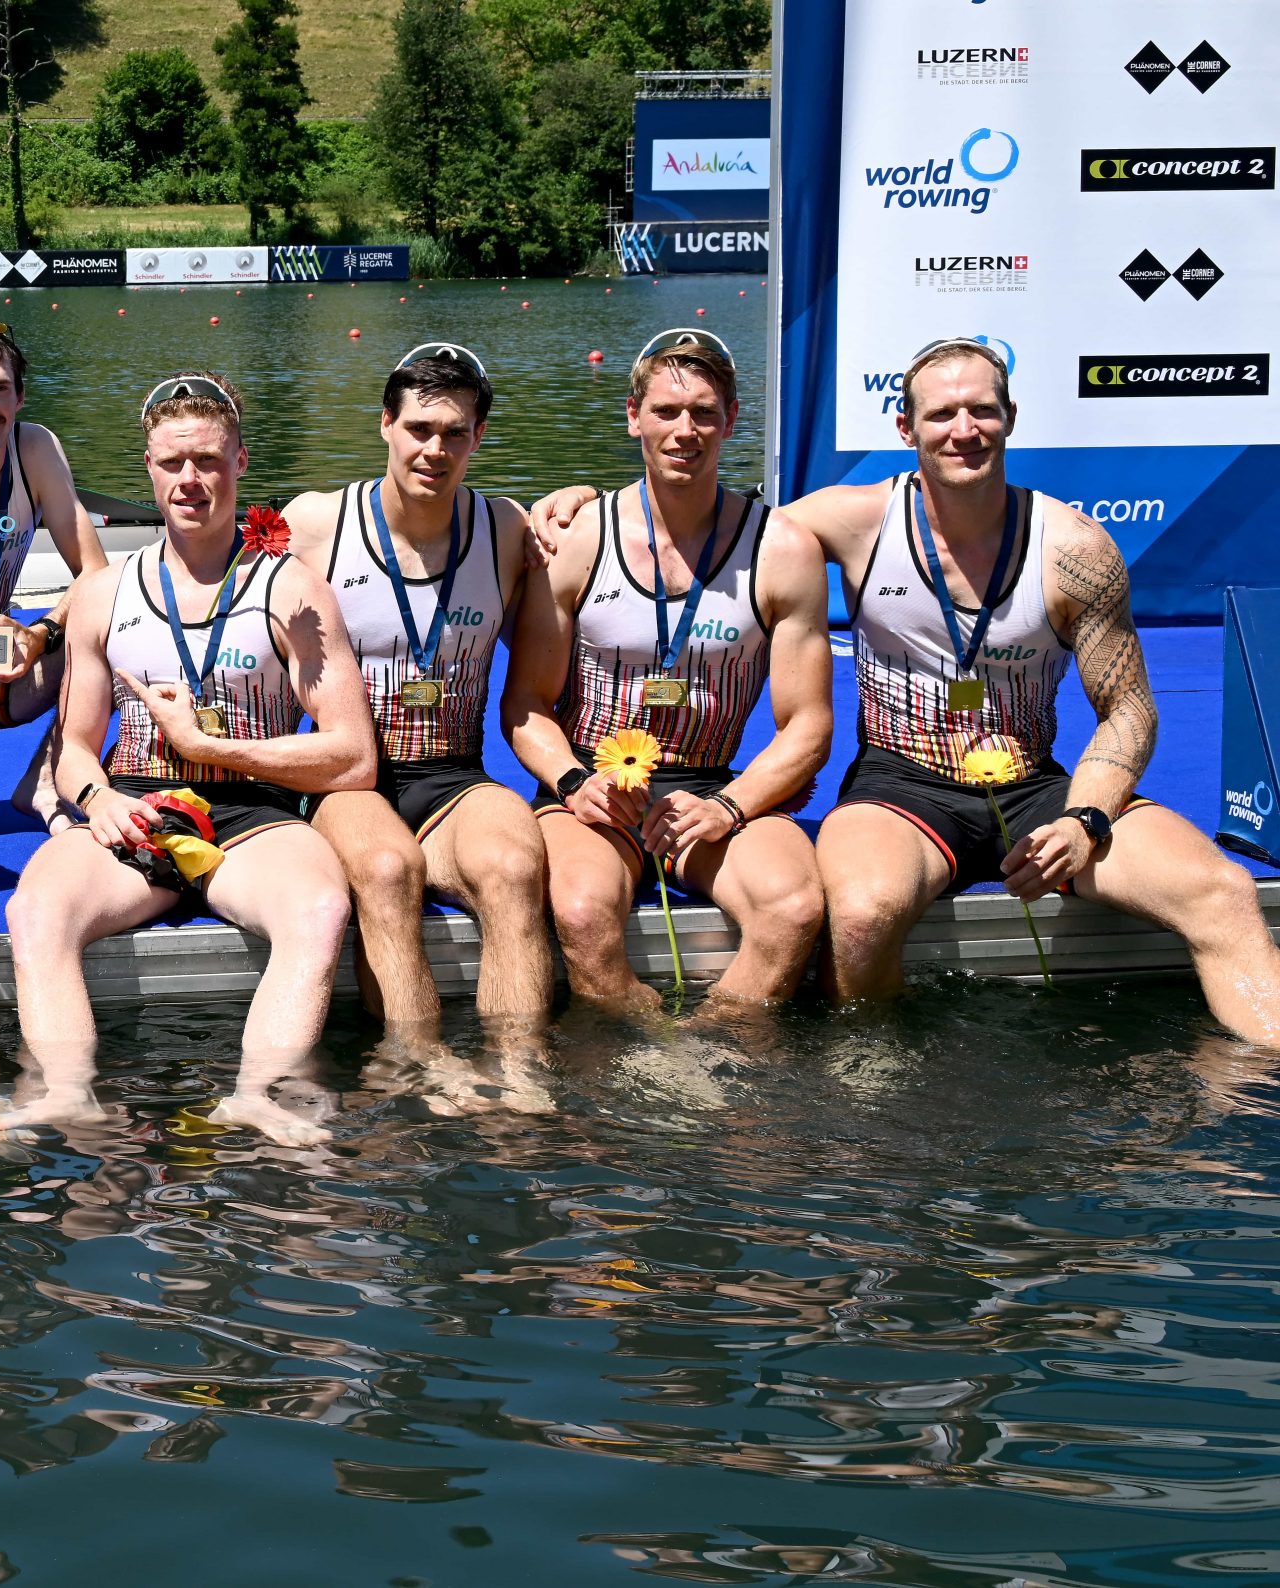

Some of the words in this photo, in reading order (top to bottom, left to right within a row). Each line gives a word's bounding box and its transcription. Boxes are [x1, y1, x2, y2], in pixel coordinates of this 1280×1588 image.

[917, 47, 1016, 64] LUZERN
[1196, 60, 1221, 70] CORNER
[865, 158, 954, 187] world
[1131, 159, 1242, 177] concept
[1247, 158, 1265, 175] 2
[883, 187, 991, 214] rowing
[674, 231, 769, 253] LUCERN
[53, 257, 117, 268] PHÄNOMEN
[359, 252, 393, 260] LUCERNE
[915, 256, 1013, 272] LUZERN
[182, 272, 213, 280] Schindler
[230, 271, 260, 279] Schindler
[1191, 268, 1215, 277] CORNER
[1127, 365, 1236, 383] concept
[1241, 364, 1258, 381] 2
[688, 618, 740, 642] wilo
[983, 644, 1037, 661] wilo
[1225, 789, 1253, 808] world
[1228, 803, 1264, 831] rowing
